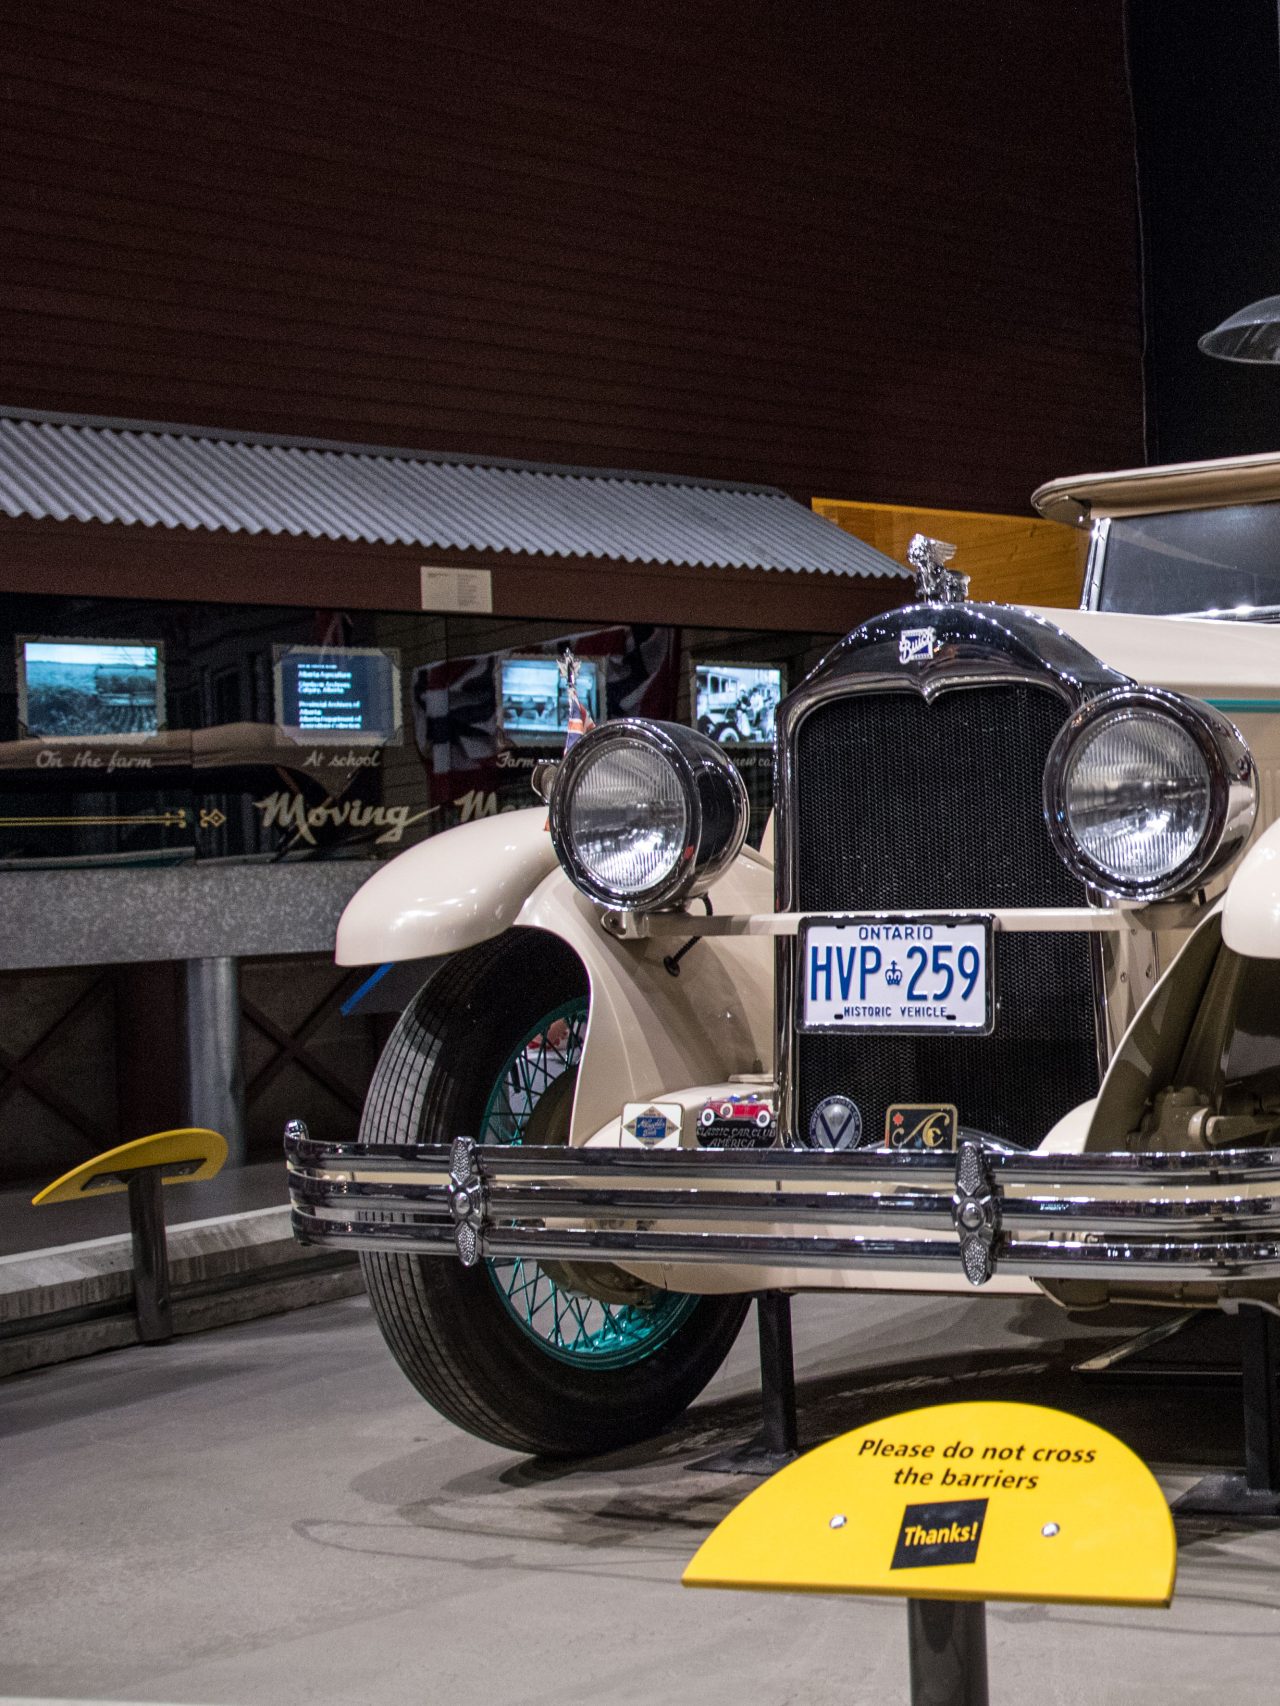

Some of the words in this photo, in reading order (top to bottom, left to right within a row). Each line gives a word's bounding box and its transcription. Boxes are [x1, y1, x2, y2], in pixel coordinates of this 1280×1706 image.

[899, 626, 937, 664] Buick
[36, 750, 63, 768] On
[73, 750, 104, 768] the
[107, 750, 153, 773] farm
[302, 751, 322, 767] At
[328, 751, 381, 767] school
[254, 791, 441, 845] Moving
[858, 926, 934, 941] ONTARIO
[810, 945, 882, 1001] HVP
[906, 945, 980, 1001] 259
[843, 1006, 892, 1017] HISTORIC
[900, 1006, 948, 1018] VEHICLE
[697, 1127, 730, 1137] CLASSIC
[731, 1127, 751, 1138] CAR
[752, 1128, 776, 1138] CLUB
[857, 1439, 935, 1458] Please
[942, 1441, 974, 1459] do
[981, 1444, 1026, 1461] not
[1032, 1448, 1097, 1463] cross
[893, 1467, 934, 1486] the
[940, 1468, 1040, 1490] barriers
[904, 1521, 979, 1547] Thanks!
